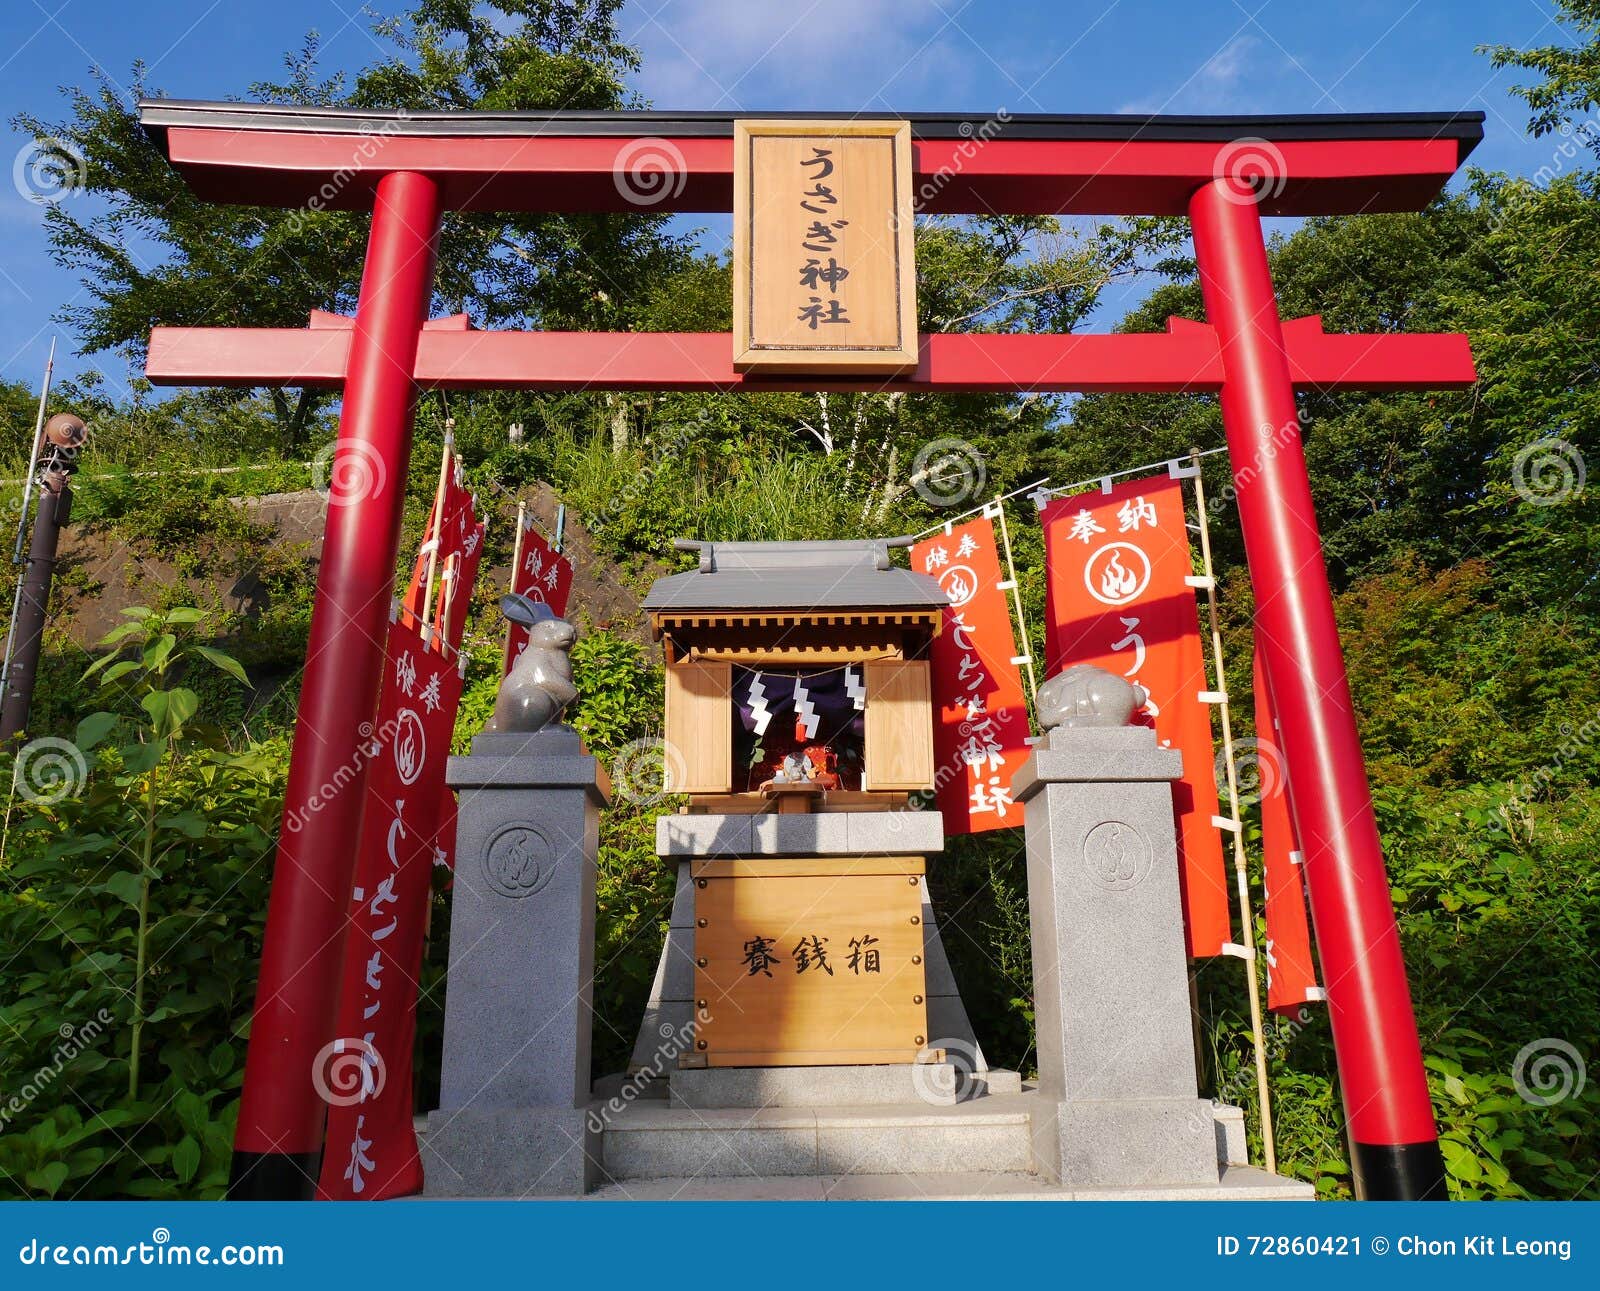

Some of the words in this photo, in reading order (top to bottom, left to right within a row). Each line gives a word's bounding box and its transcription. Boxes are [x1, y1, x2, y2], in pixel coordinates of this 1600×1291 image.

[796, 147, 851, 330] うさぎ神社
[1065, 495, 1159, 544] 奉納
[741, 934, 881, 978] 賽銭箱
